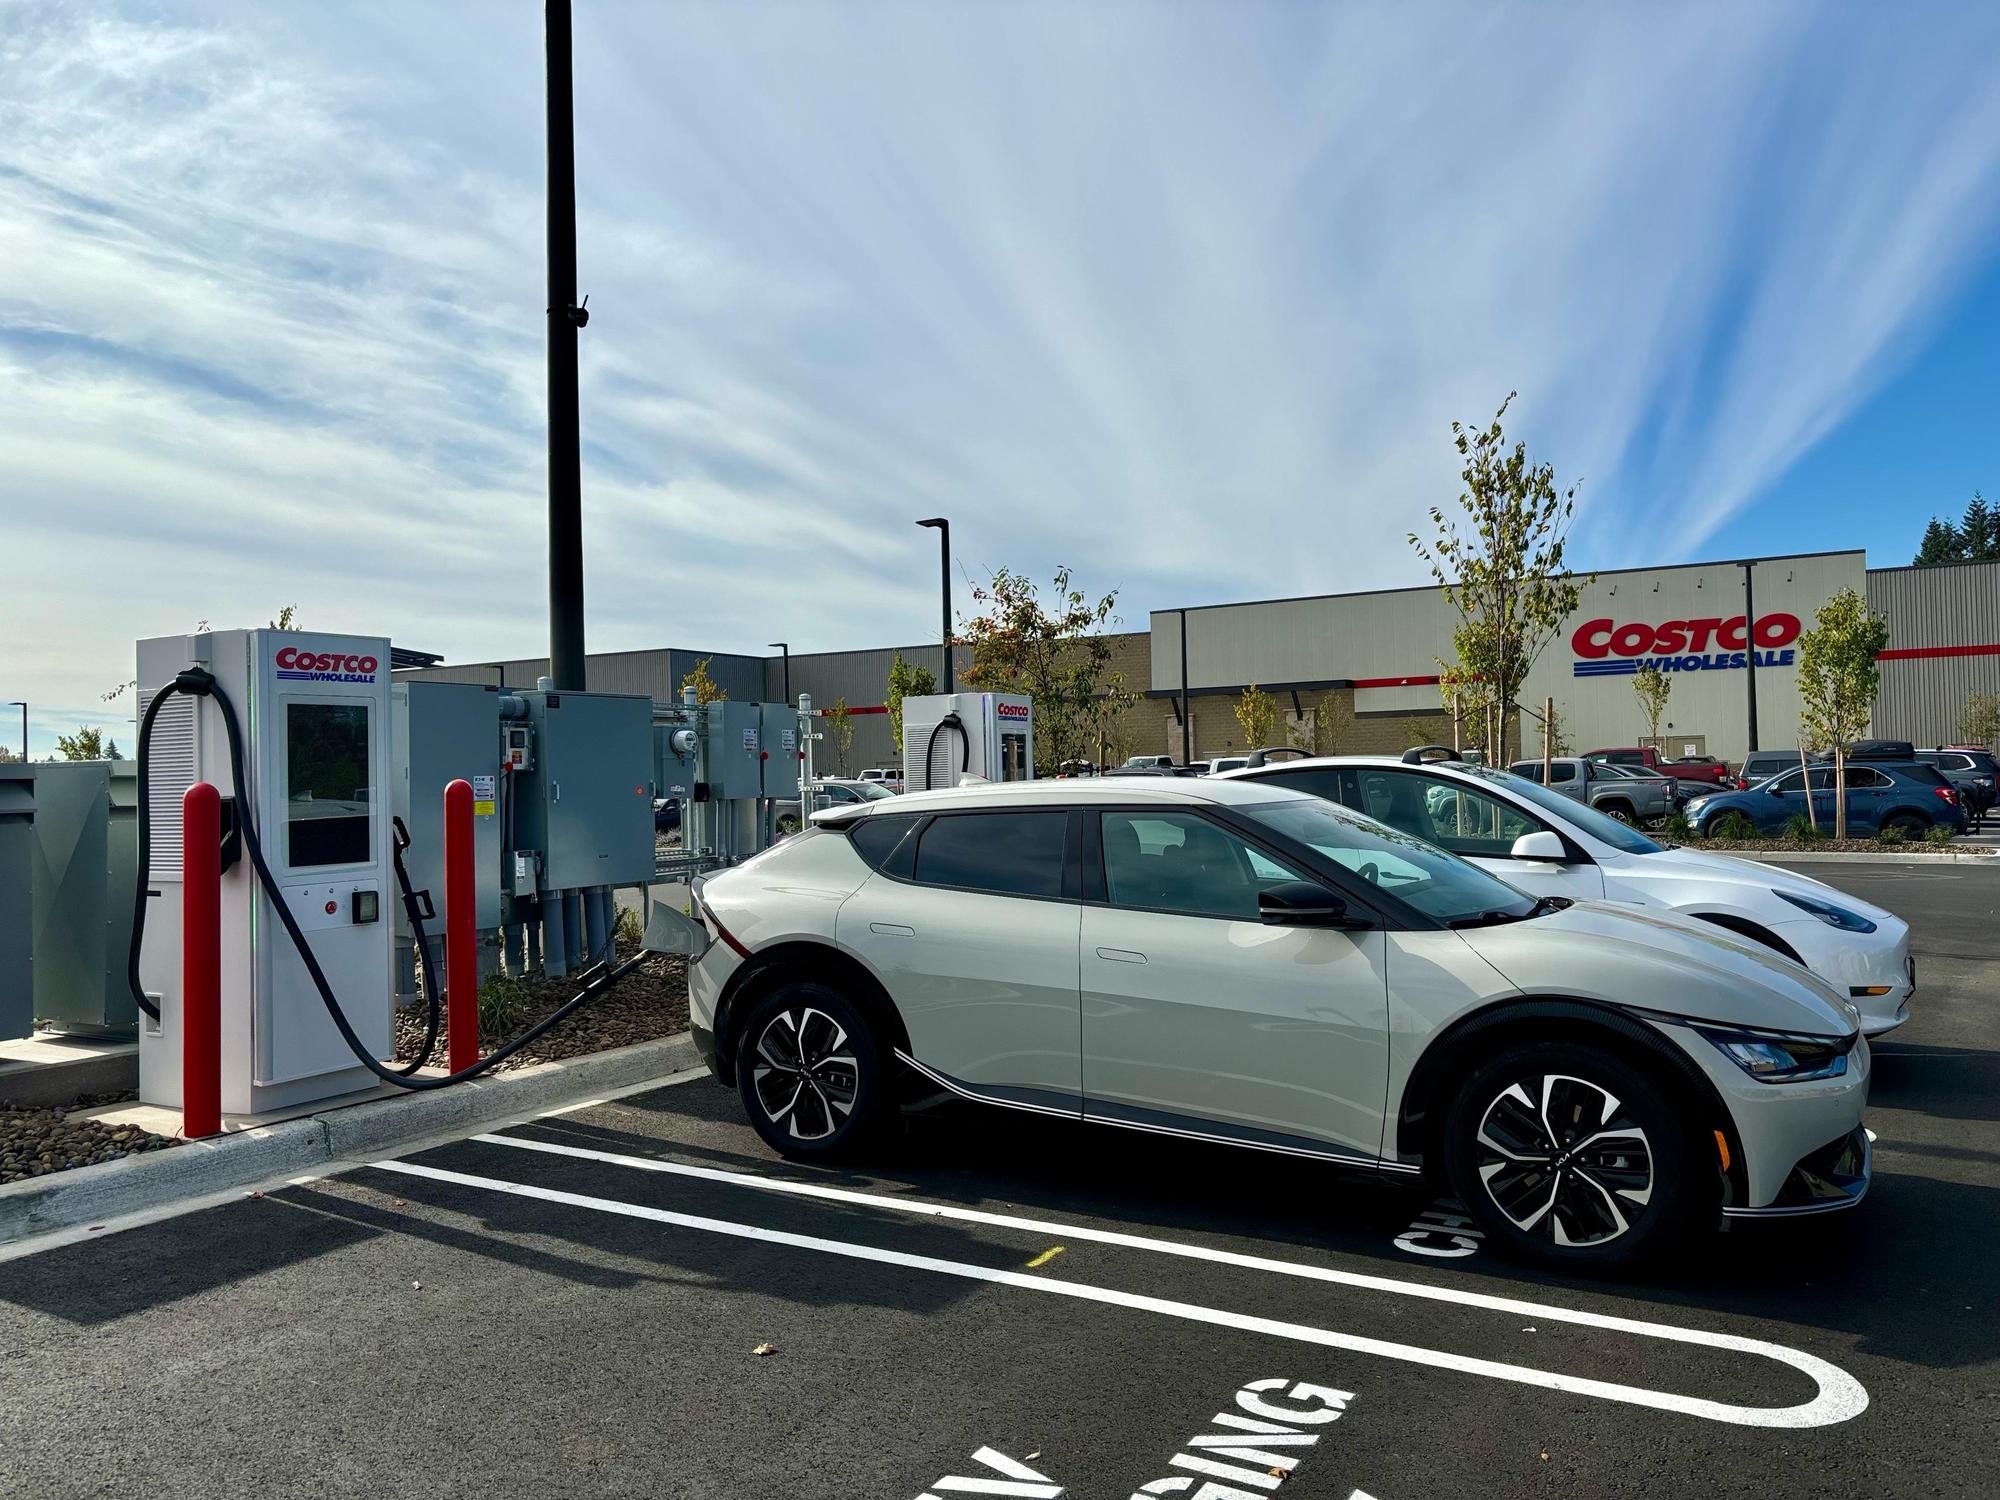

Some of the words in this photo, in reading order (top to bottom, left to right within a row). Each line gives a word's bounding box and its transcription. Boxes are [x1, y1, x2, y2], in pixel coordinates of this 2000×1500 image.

[1571, 613, 1801, 658] COSTCO
[276, 647, 378, 673] COSTCO
[309, 672, 375, 683] WHOLESALE
[998, 702, 1029, 716] COSTCO
